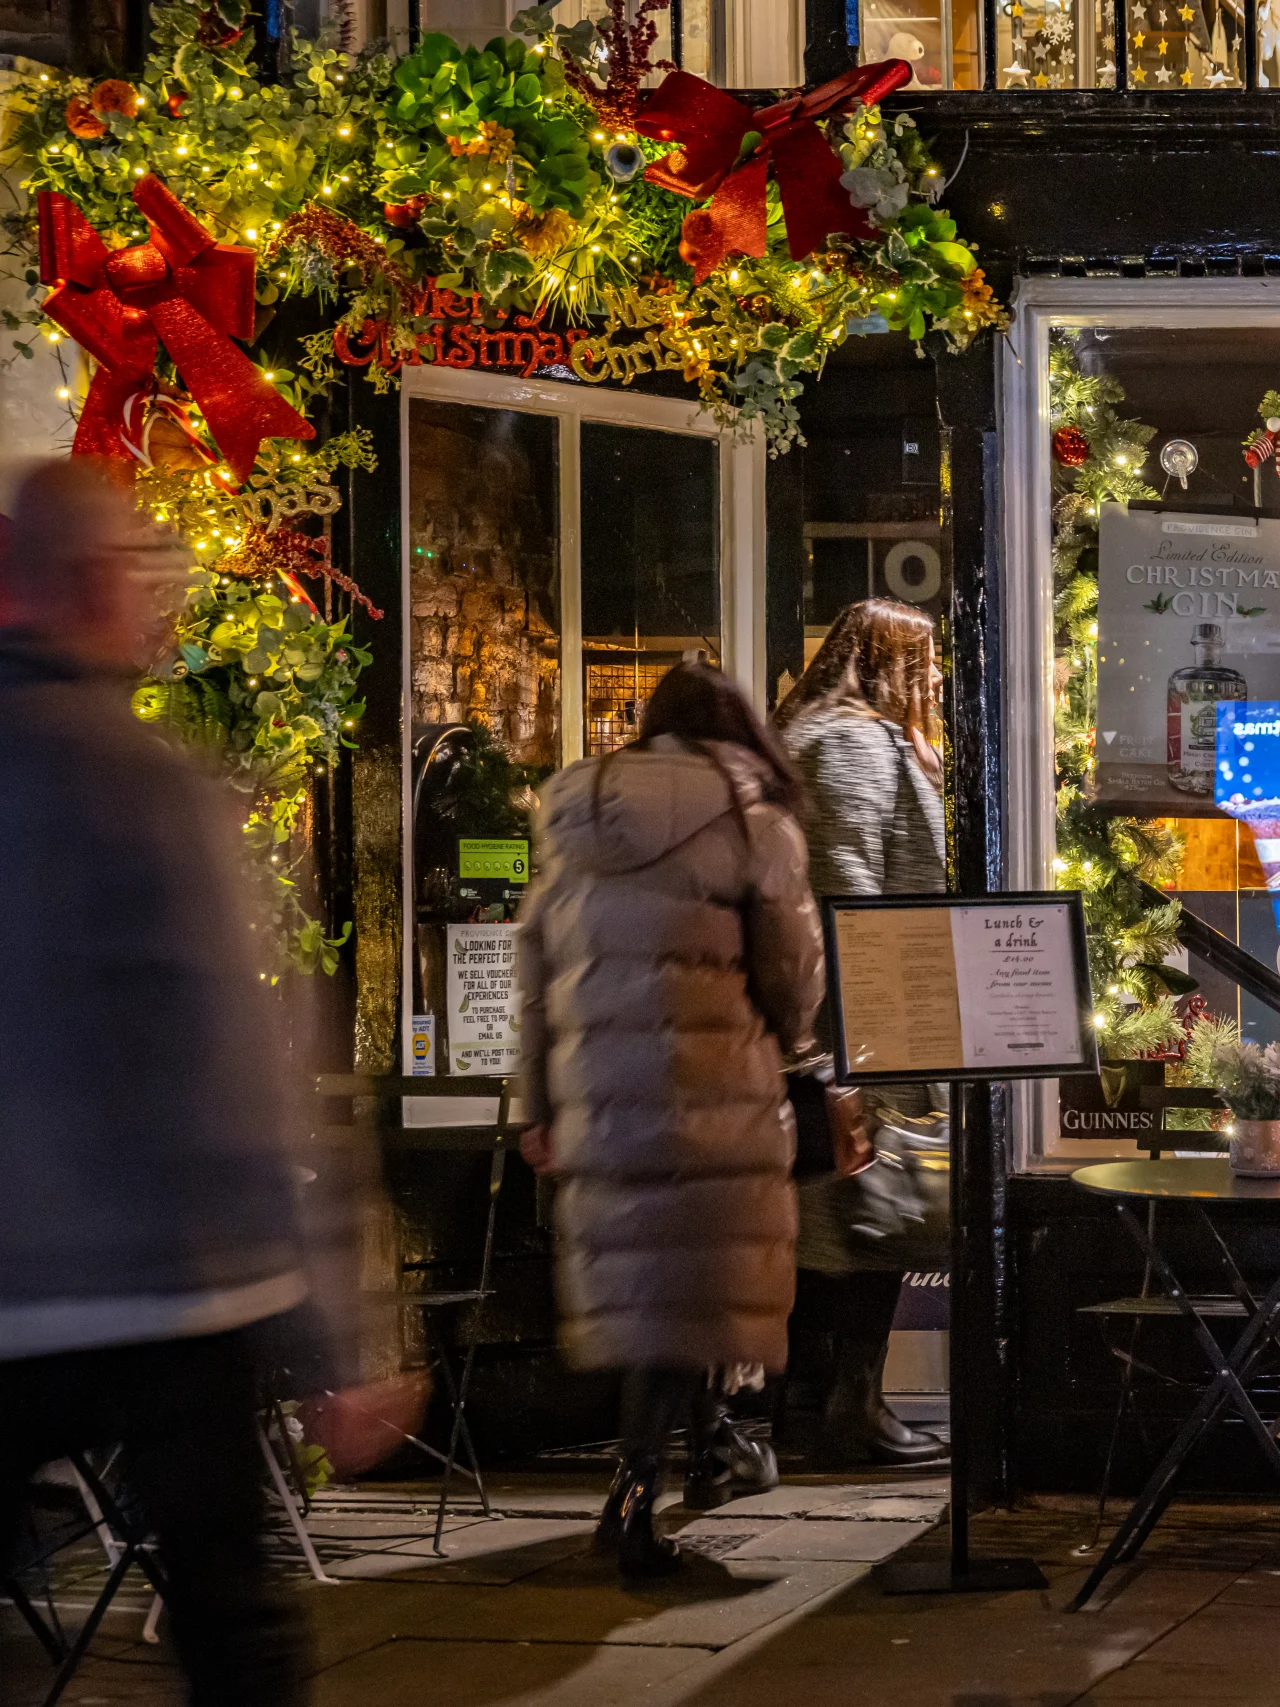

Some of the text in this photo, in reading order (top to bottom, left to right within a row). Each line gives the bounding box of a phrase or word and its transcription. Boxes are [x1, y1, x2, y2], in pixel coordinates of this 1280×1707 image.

[1234, 527, 1253, 537] GIN
[1149, 540, 1265, 565] Limited Edition
[1172, 592, 1240, 619] GIN
[515, 860, 523, 873] 5
[984, 915, 1022, 929] Lunch
[994, 932, 1038, 947] a drink
[465, 940, 512, 951] LOOKING FOR
[453, 952, 518, 965] THE PERFECT GIFT
[458, 969, 518, 980] WE SELL VOUCHERS
[463, 980, 512, 990] FOR ALL OF OUR
[467, 991, 509, 1000] EXPERIENCES
[480, 1006, 506, 1014] PURCHASE
[477, 1015, 489, 1023] FREE
[461, 1050, 472, 1058] AND
